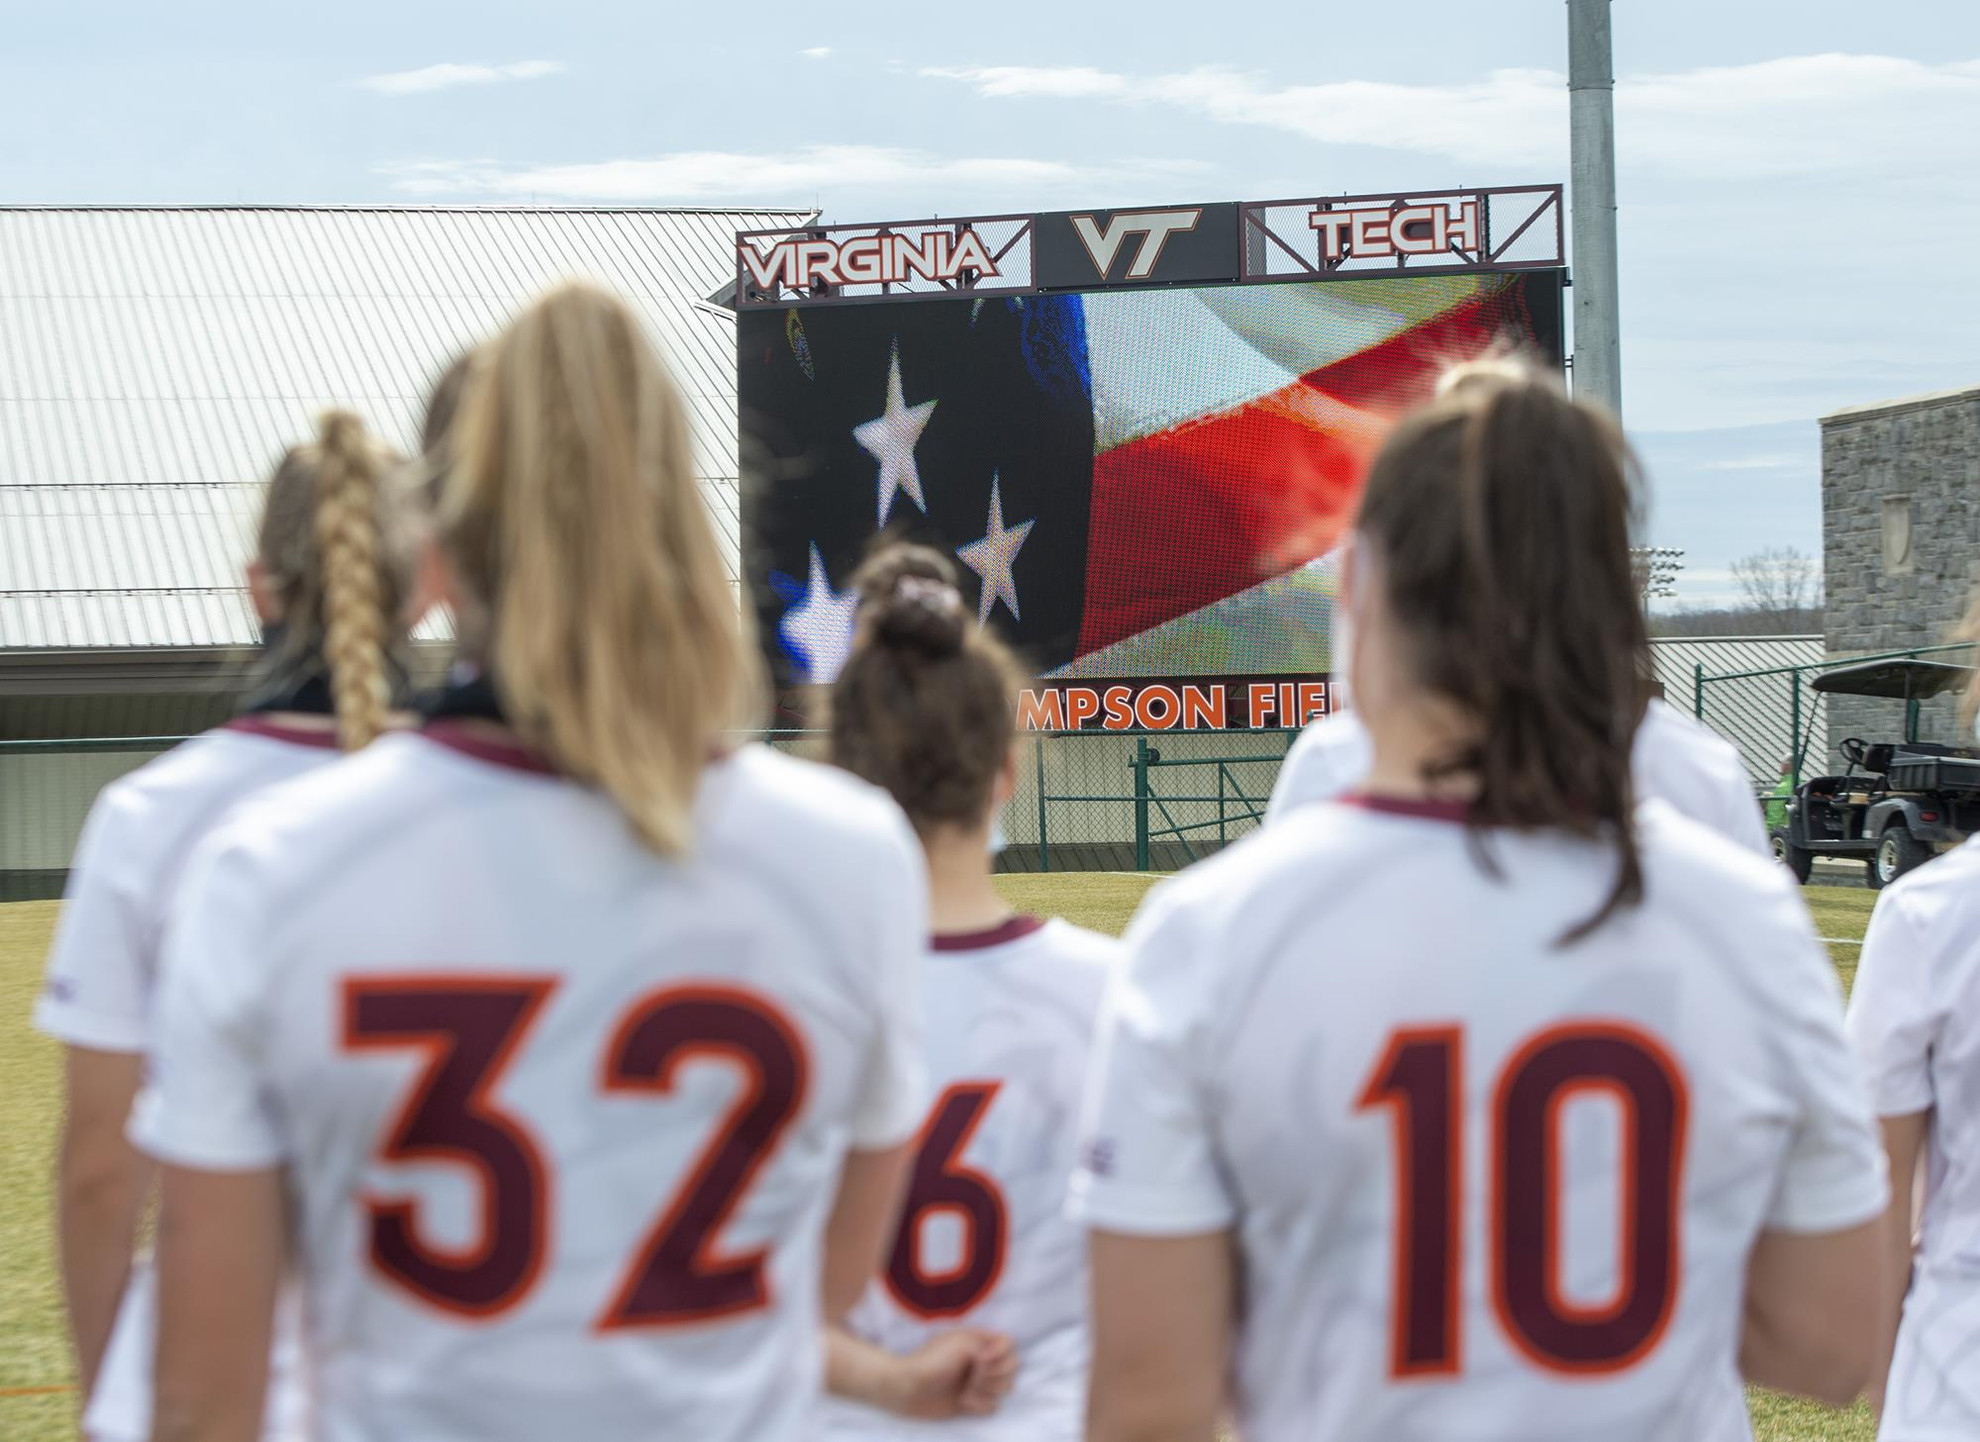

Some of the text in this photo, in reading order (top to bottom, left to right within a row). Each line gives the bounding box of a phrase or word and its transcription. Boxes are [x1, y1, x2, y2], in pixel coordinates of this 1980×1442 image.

[739, 201, 1479, 289] VIRGINIA VT TECH
[336, 973, 812, 1337] 32
[878, 1079, 1007, 1321] 6
[1354, 1019, 1691, 1382] 10
